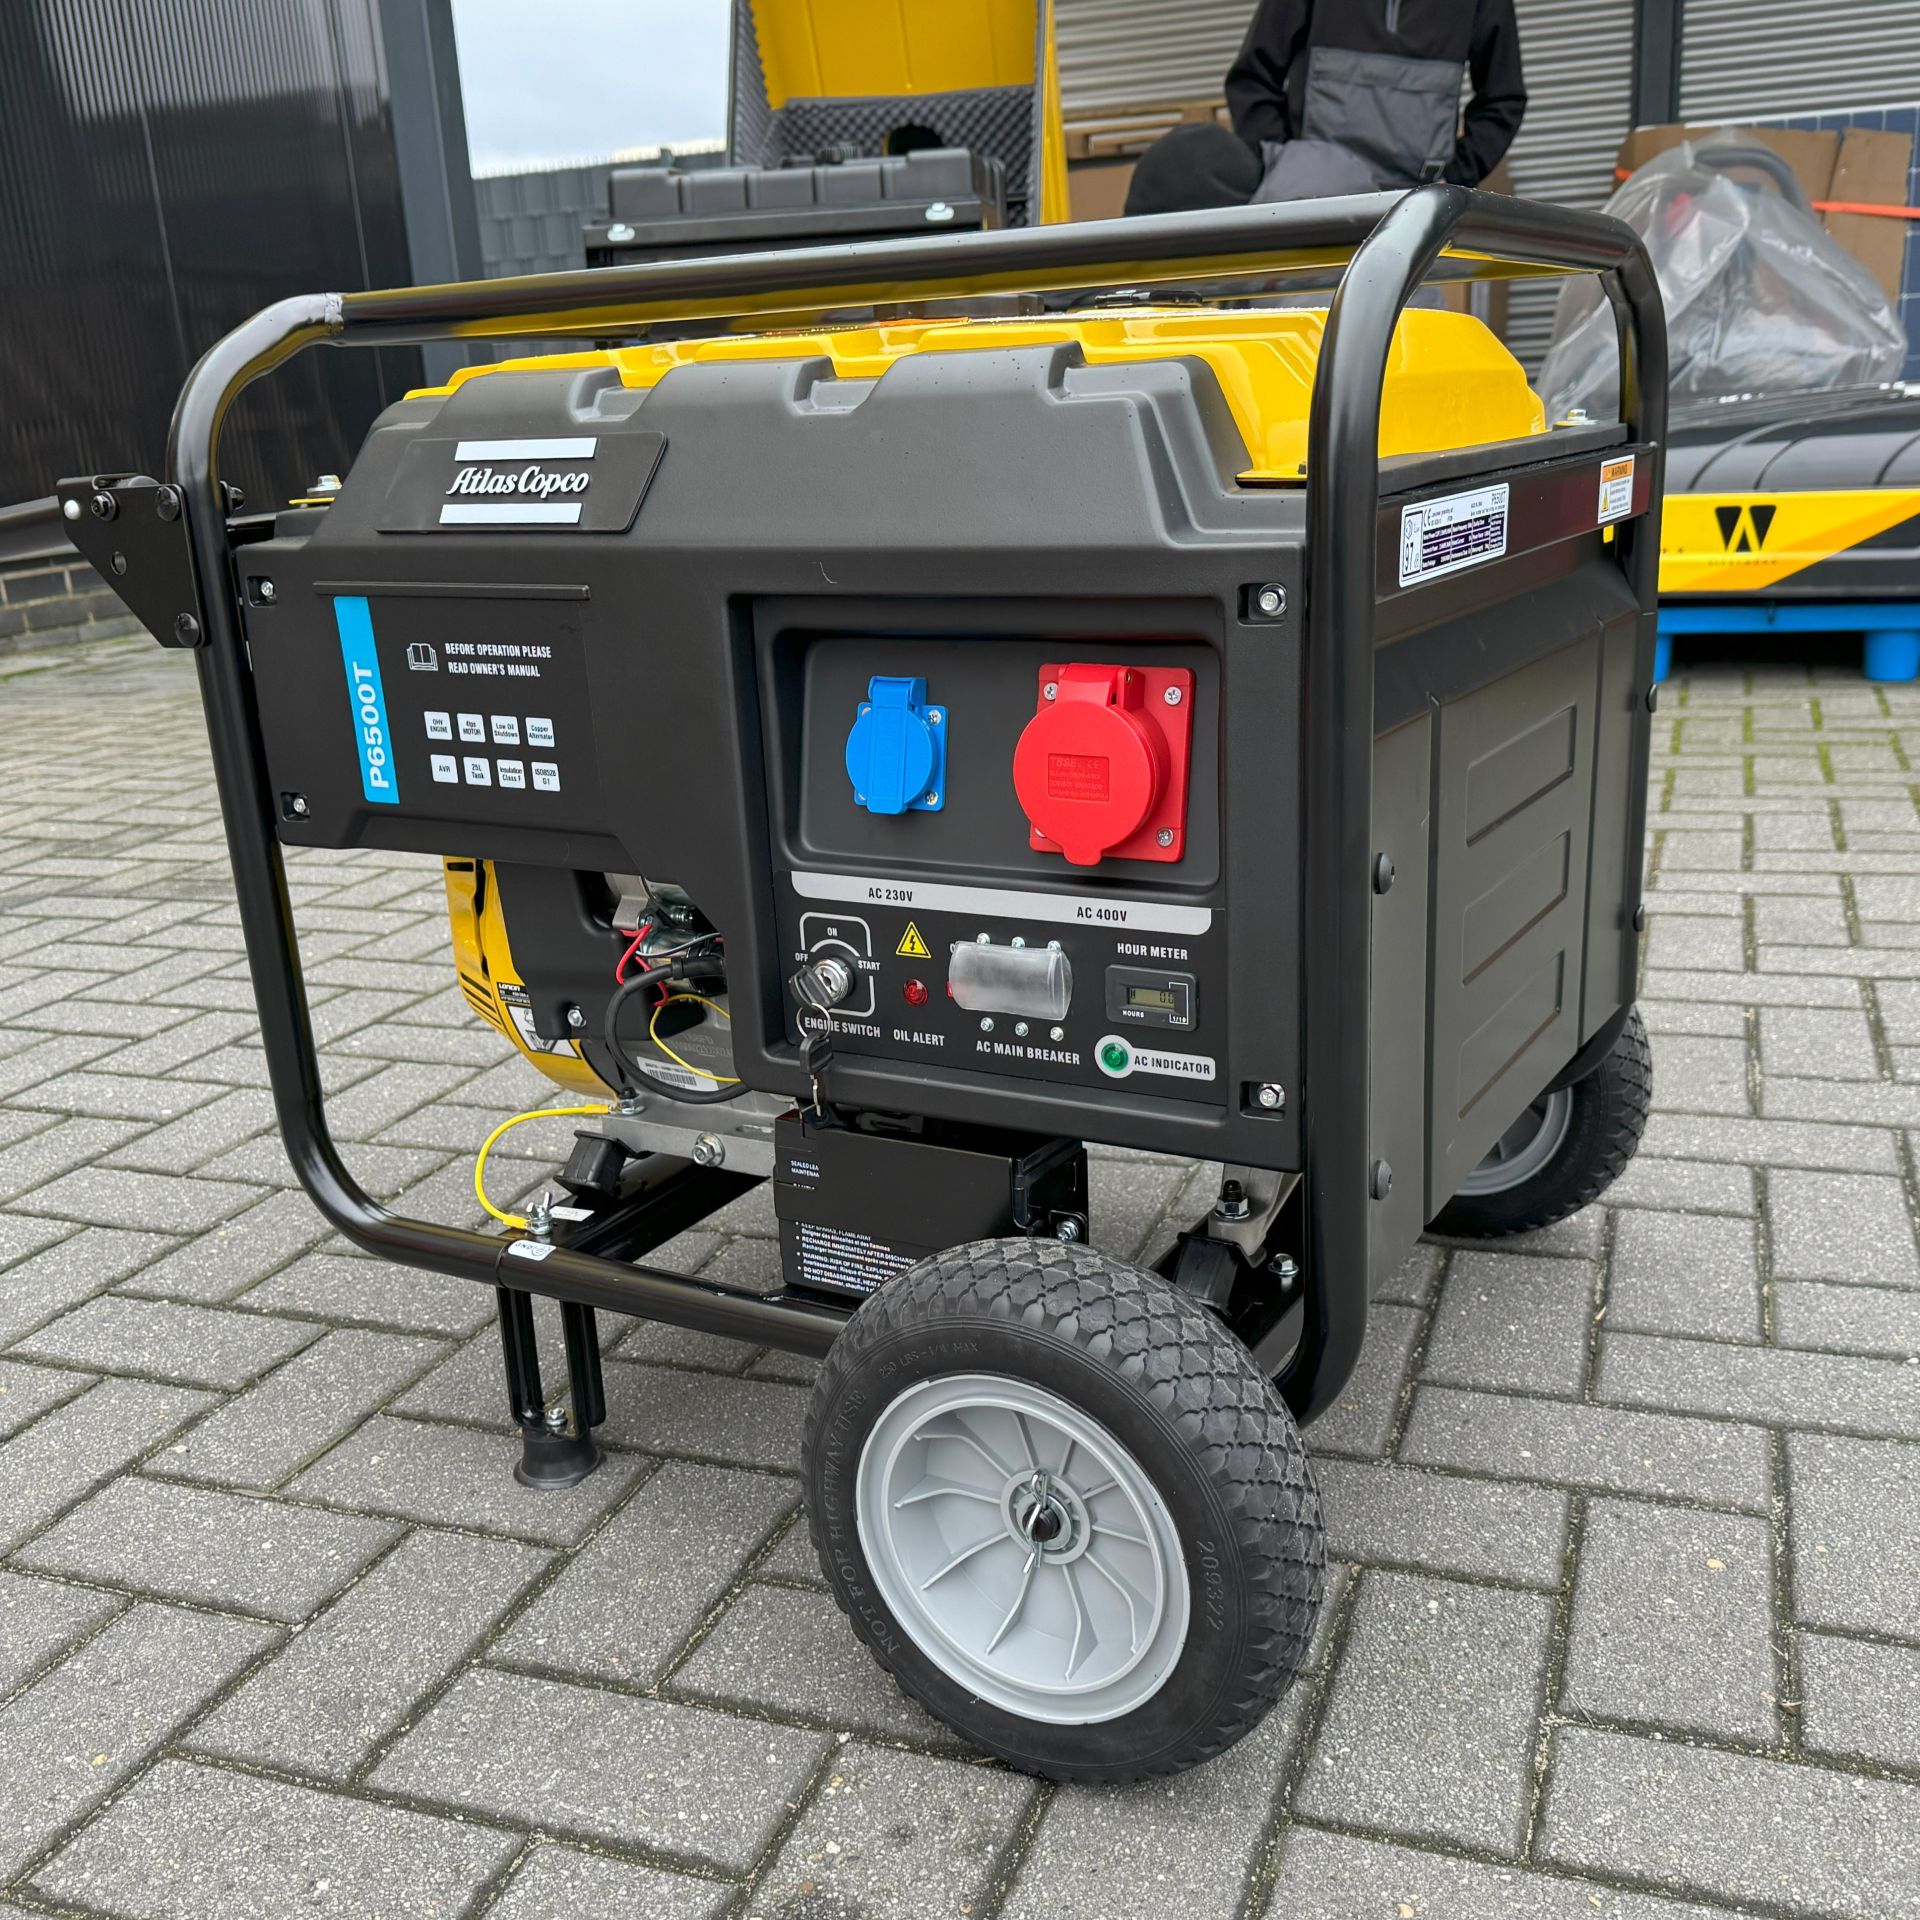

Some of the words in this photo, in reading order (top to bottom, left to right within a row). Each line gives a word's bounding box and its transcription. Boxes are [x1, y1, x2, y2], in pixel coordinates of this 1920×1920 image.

[445, 467, 518, 495] Atlas
[518, 466, 589, 499] Copco
[445, 642, 475, 655] BEFORE
[477, 643, 520, 657] OPERATION
[521, 645, 552, 659] PLEASE
[447, 662, 469, 674] READ
[469, 662, 506, 676] OWNER'S
[507, 664, 541, 677] MANUAL
[353, 661, 390, 788] P6500T
[430, 725, 448, 734] ENGINE
[463, 728, 481, 736] MOTOR
[438, 765, 450, 773] AVR
[472, 771, 484, 779] Tank
[502, 774, 517, 782] Class
[868, 887, 882, 900] AC
[885, 888, 913, 902] 230V
[1076, 906, 1092, 919] AC
[1096, 908, 1128, 922] 400V
[827, 927, 838, 936] ON
[794, 952, 808, 962] OFF
[1117, 942, 1147, 956] HOUR
[1150, 945, 1188, 960] METER
[857, 959, 880, 971] START
[1122, 1009, 1145, 1018] HOURS
[842, 1022, 880, 1038] SWITCH
[893, 1029, 911, 1042] OIL
[912, 1032, 945, 1047] ALERT
[976, 1040, 991, 1053] AC
[994, 1042, 1024, 1058] MAIN
[1026, 1047, 1081, 1065] BREAKER
[1134, 1055, 1148, 1067] AC
[1151, 1057, 1211, 1075] INDICATOR
[867, 1249, 884, 1258] AFTER
[824, 1432, 844, 1540] HIGHWAY
[834, 1548, 866, 1599] FOR
[860, 1604, 901, 1654] NOT
